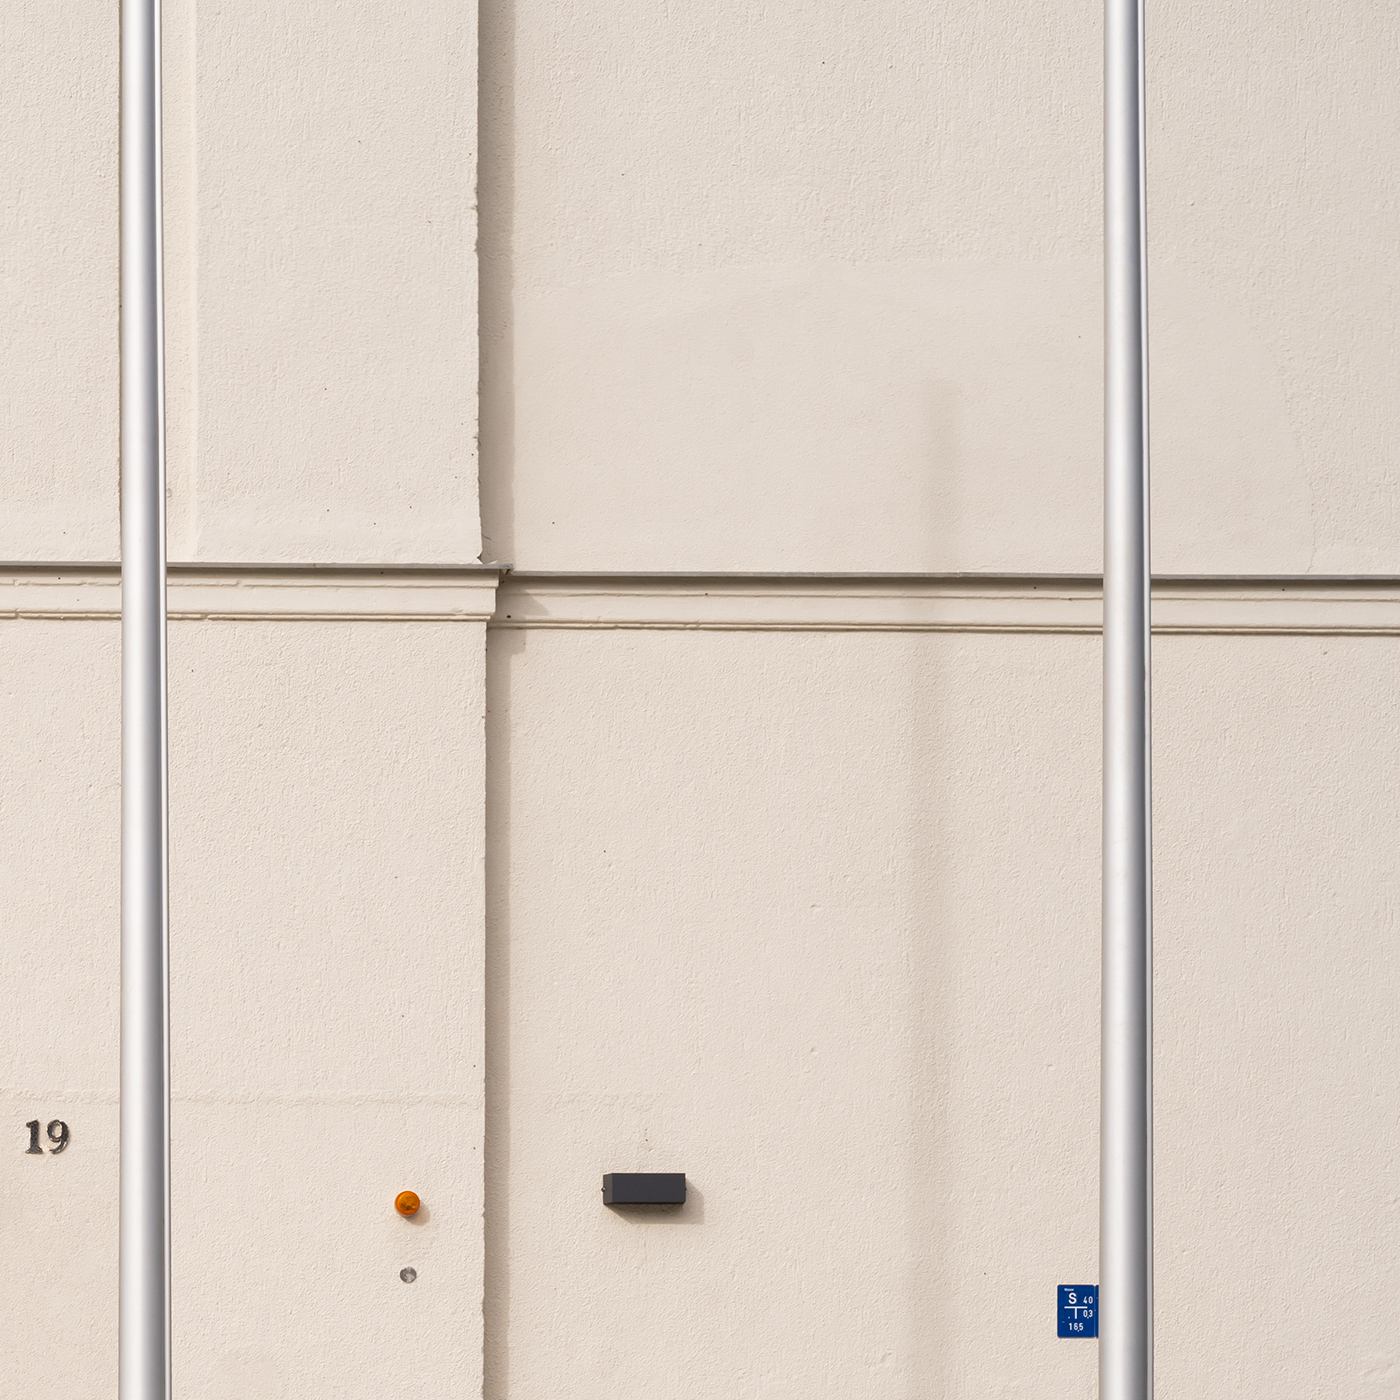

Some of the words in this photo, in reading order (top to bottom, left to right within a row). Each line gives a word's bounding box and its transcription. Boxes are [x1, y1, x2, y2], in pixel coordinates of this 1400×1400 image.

[25, 1119, 69, 1154] 19
[1068, 1292, 1077, 1304] S
[1083, 1295, 1093, 1304] 40
